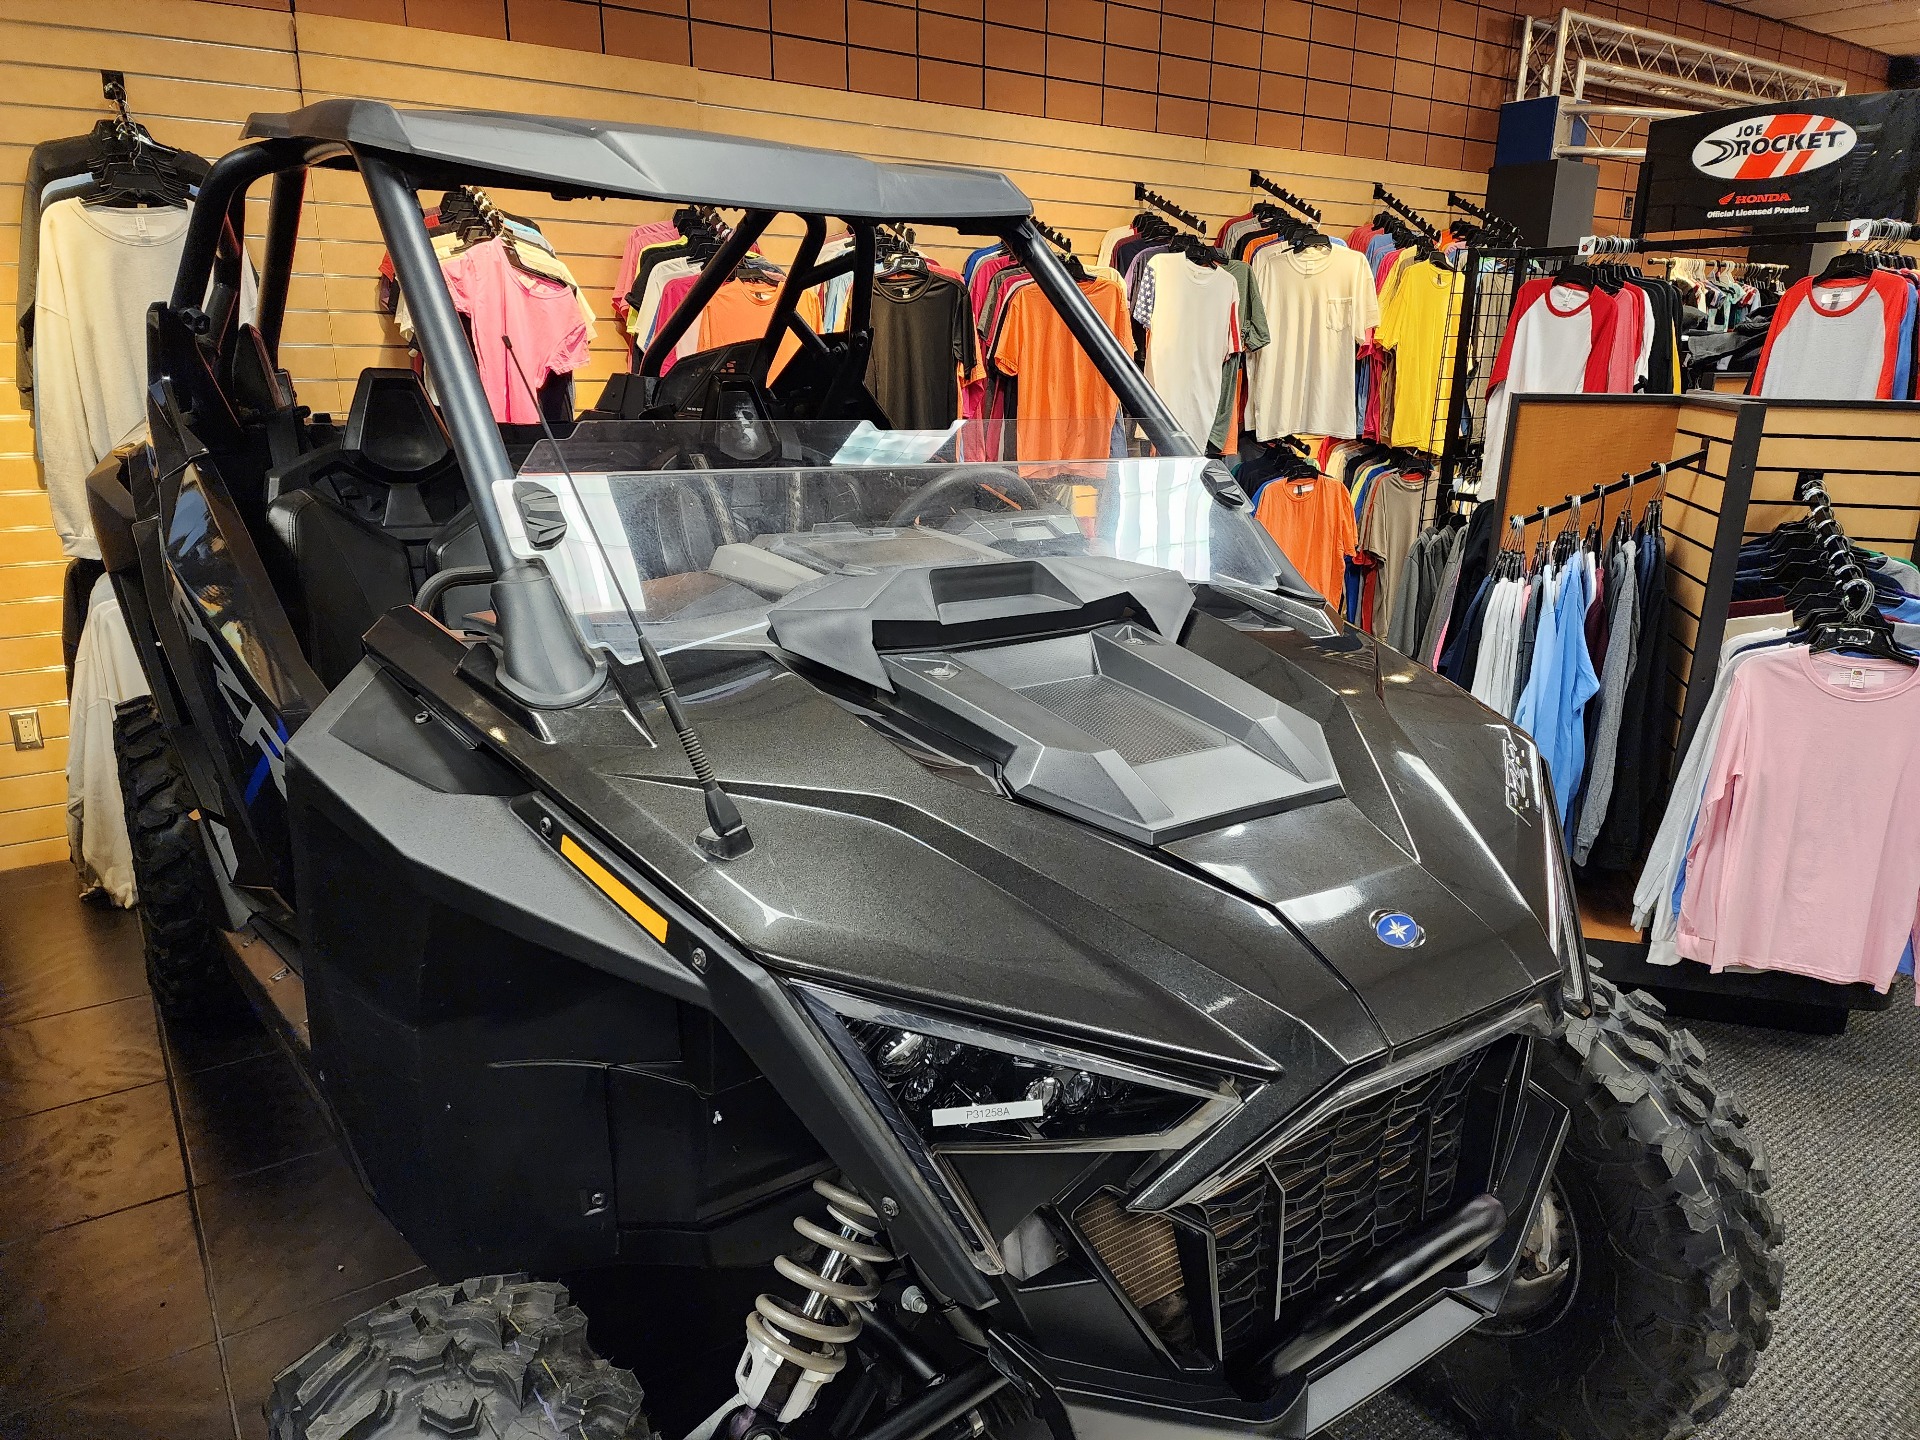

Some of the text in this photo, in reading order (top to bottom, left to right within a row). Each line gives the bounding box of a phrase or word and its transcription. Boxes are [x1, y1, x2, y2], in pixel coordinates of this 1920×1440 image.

[1736, 124, 1764, 138] JOE
[1734, 130, 1847, 157] ROCKET
[1735, 193, 1791, 204] HONDA
[1707, 205, 1810, 218] Official Licensed Product
[966, 1107, 1010, 1119] P31258A
